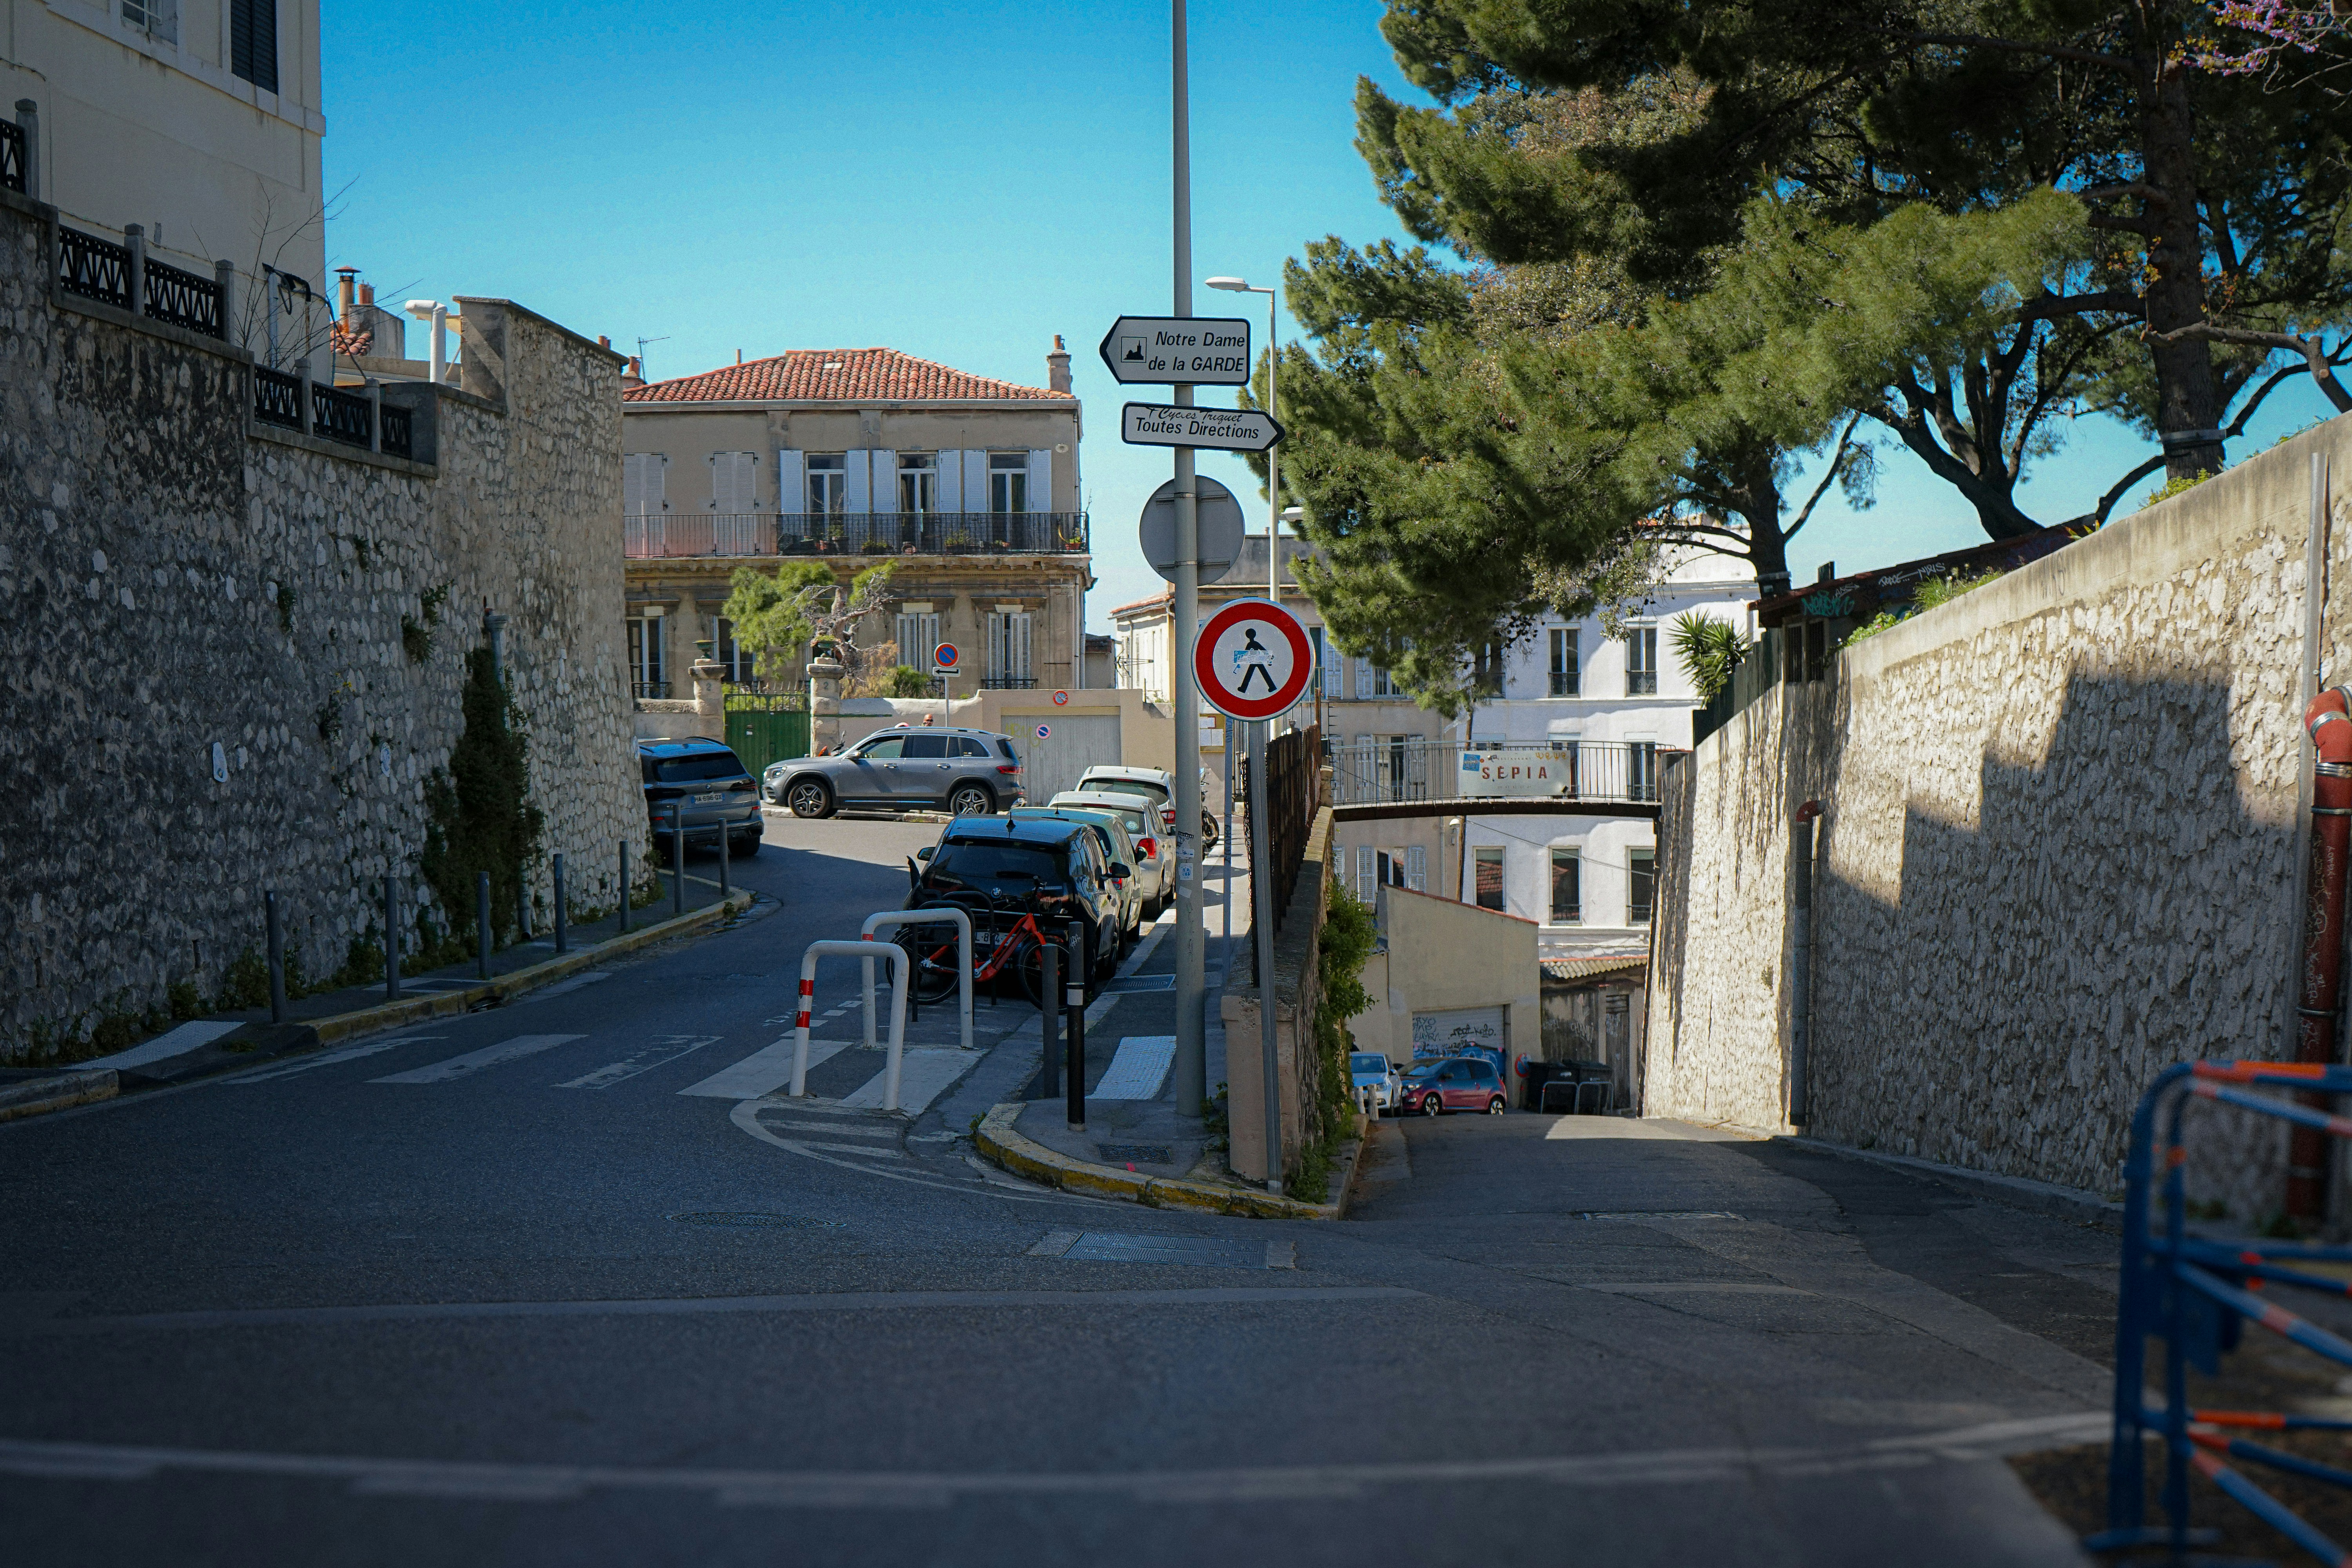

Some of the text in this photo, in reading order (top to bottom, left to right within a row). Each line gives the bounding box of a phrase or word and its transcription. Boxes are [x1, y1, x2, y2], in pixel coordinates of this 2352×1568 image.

[1156, 331, 1245, 347] Notre Dame
[1149, 356, 1245, 372] de la GARDE
[1136, 417, 1259, 439] Toutes Directions
